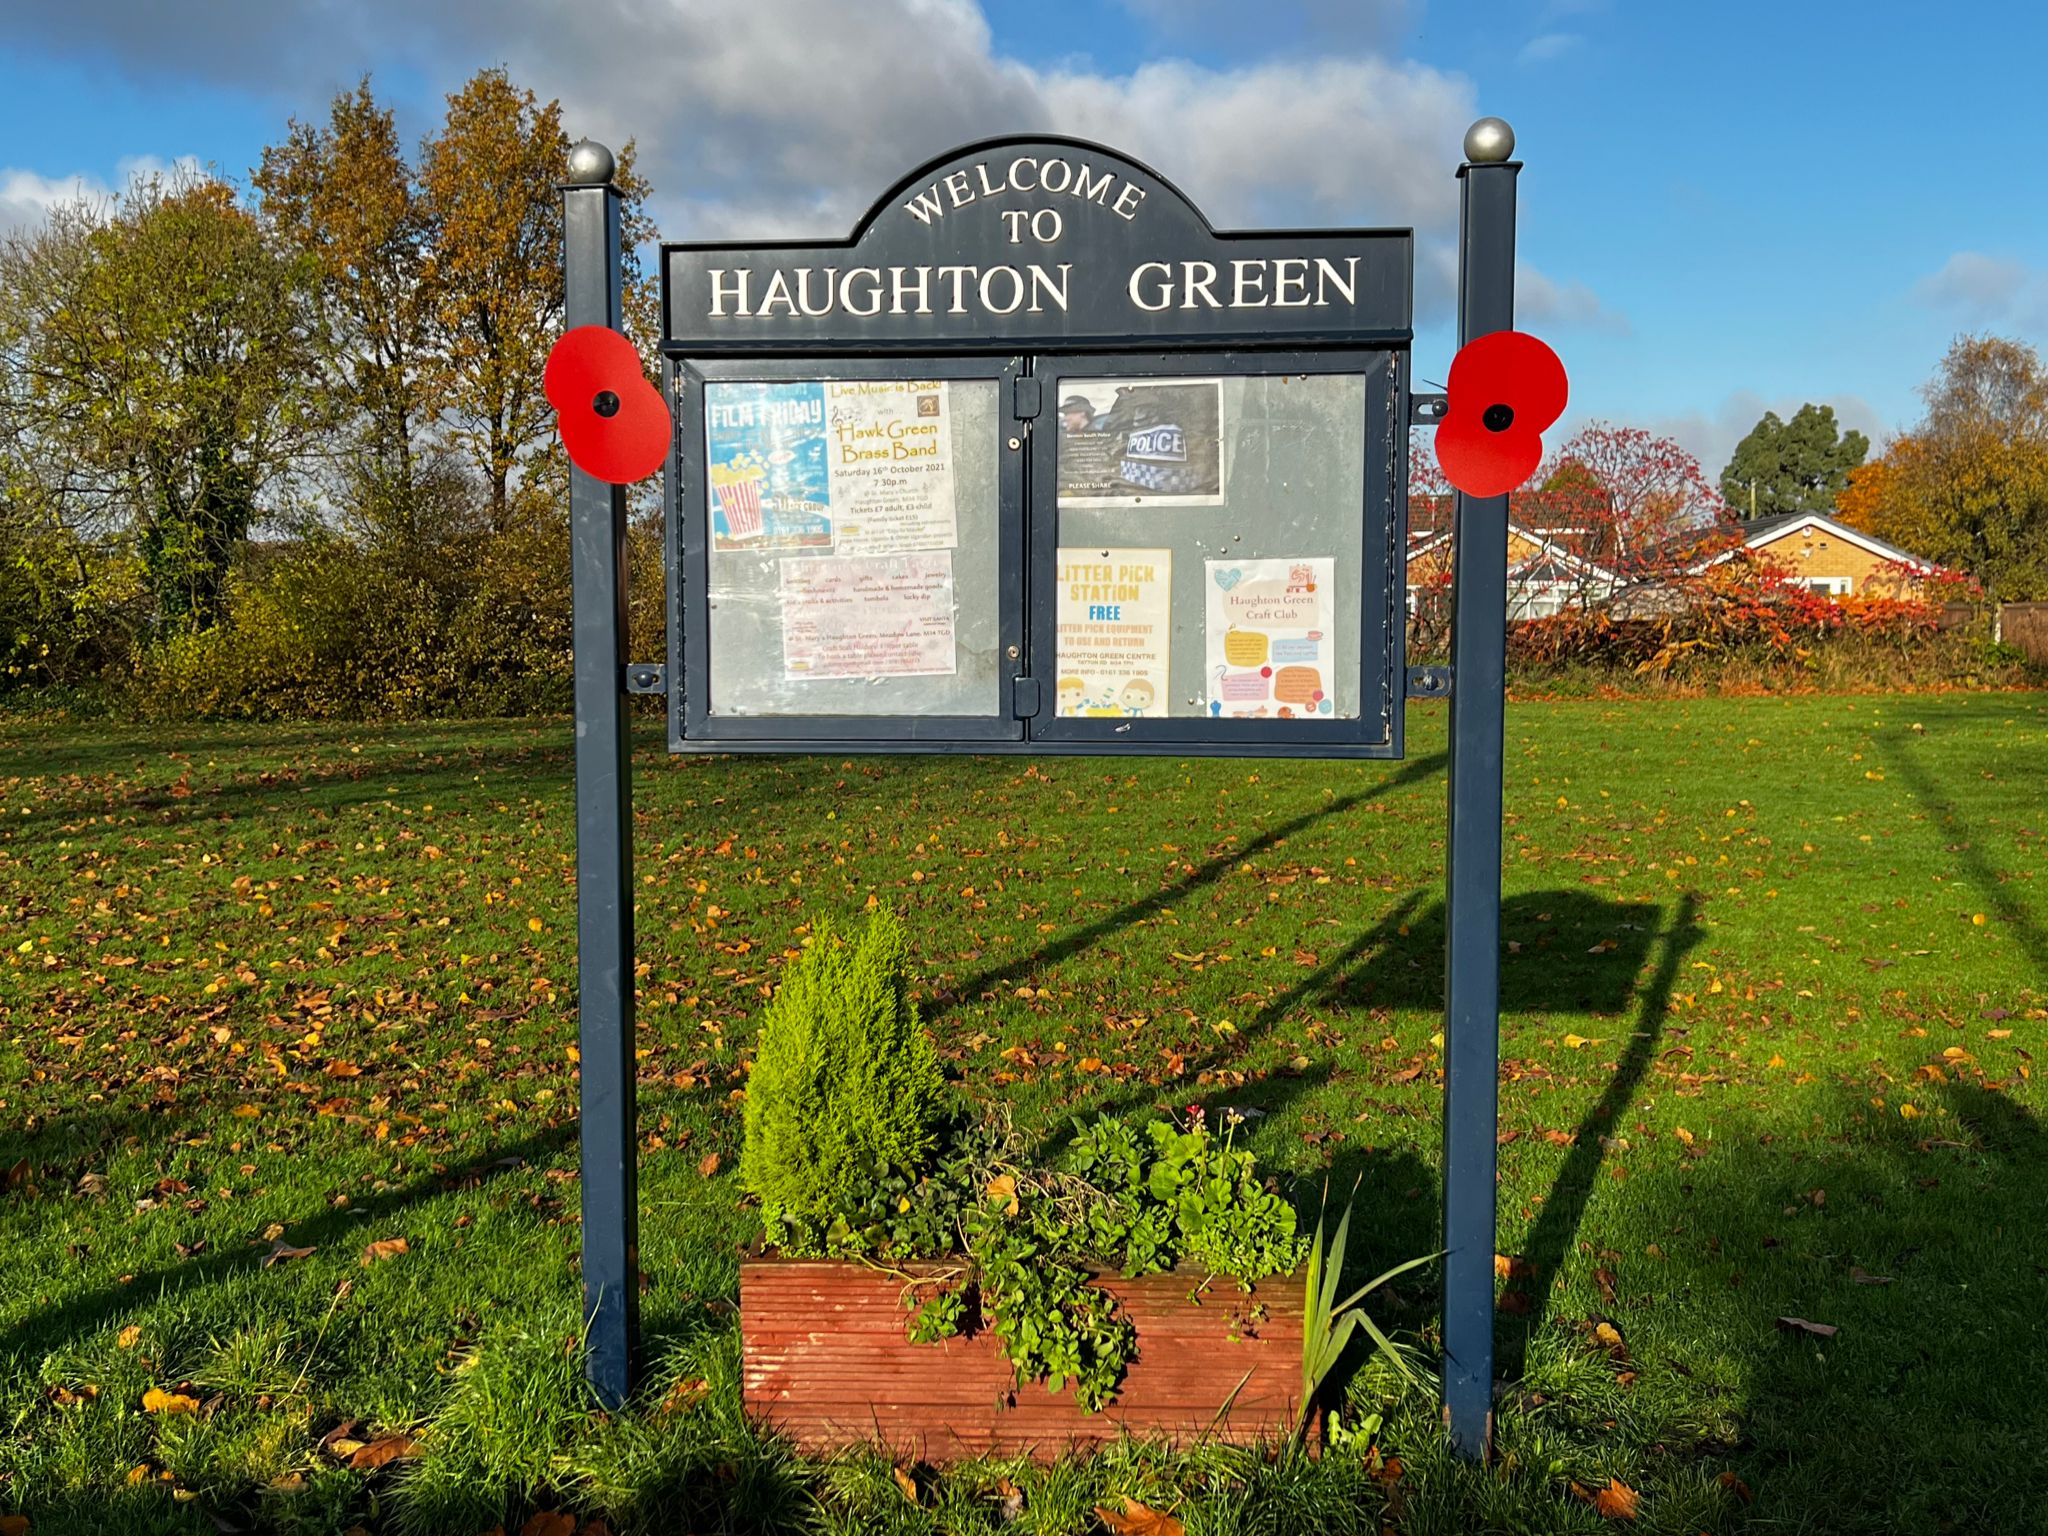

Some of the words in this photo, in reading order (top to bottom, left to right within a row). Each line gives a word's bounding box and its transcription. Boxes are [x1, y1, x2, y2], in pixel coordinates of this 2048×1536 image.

[905, 156, 1147, 225] WELCOME
[1001, 208, 1063, 244] TO
[707, 263, 1072, 318] HAUGHTON
[1128, 257, 1362, 311] GREEN
[831, 384, 855, 398] Live
[858, 382, 892, 396] Music
[895, 383, 905, 392] is
[838, 421, 884, 442] Hawk
[887, 420, 938, 439] Green
[1129, 431, 1184, 453] POLICE
[842, 444, 889, 464] Brass
[893, 440, 937, 460] Band
[834, 468, 871, 477] Saturday
[873, 467, 888, 475] 16th
[890, 465, 923, 474] October
[926, 463, 945, 471] 2021
[885, 504, 905, 513] adult,
[859, 574, 873, 583] gifts
[925, 583, 944, 592] goods
[904, 593, 920, 601] lucky
[921, 592, 931, 600] dip
[1230, 596, 1280, 607] Haughton
[1283, 595, 1313, 604] Green
[1089, 605, 1121, 620] FREE
[1246, 610, 1271, 620] Craft
[1274, 609, 1298, 619] Club
[1106, 624, 1153, 635] EQUIPMENT
[1064, 636, 1075, 646] TO
[1093, 637, 1110, 646] AND
[1056, 652, 1098, 660] HAUGHTON
